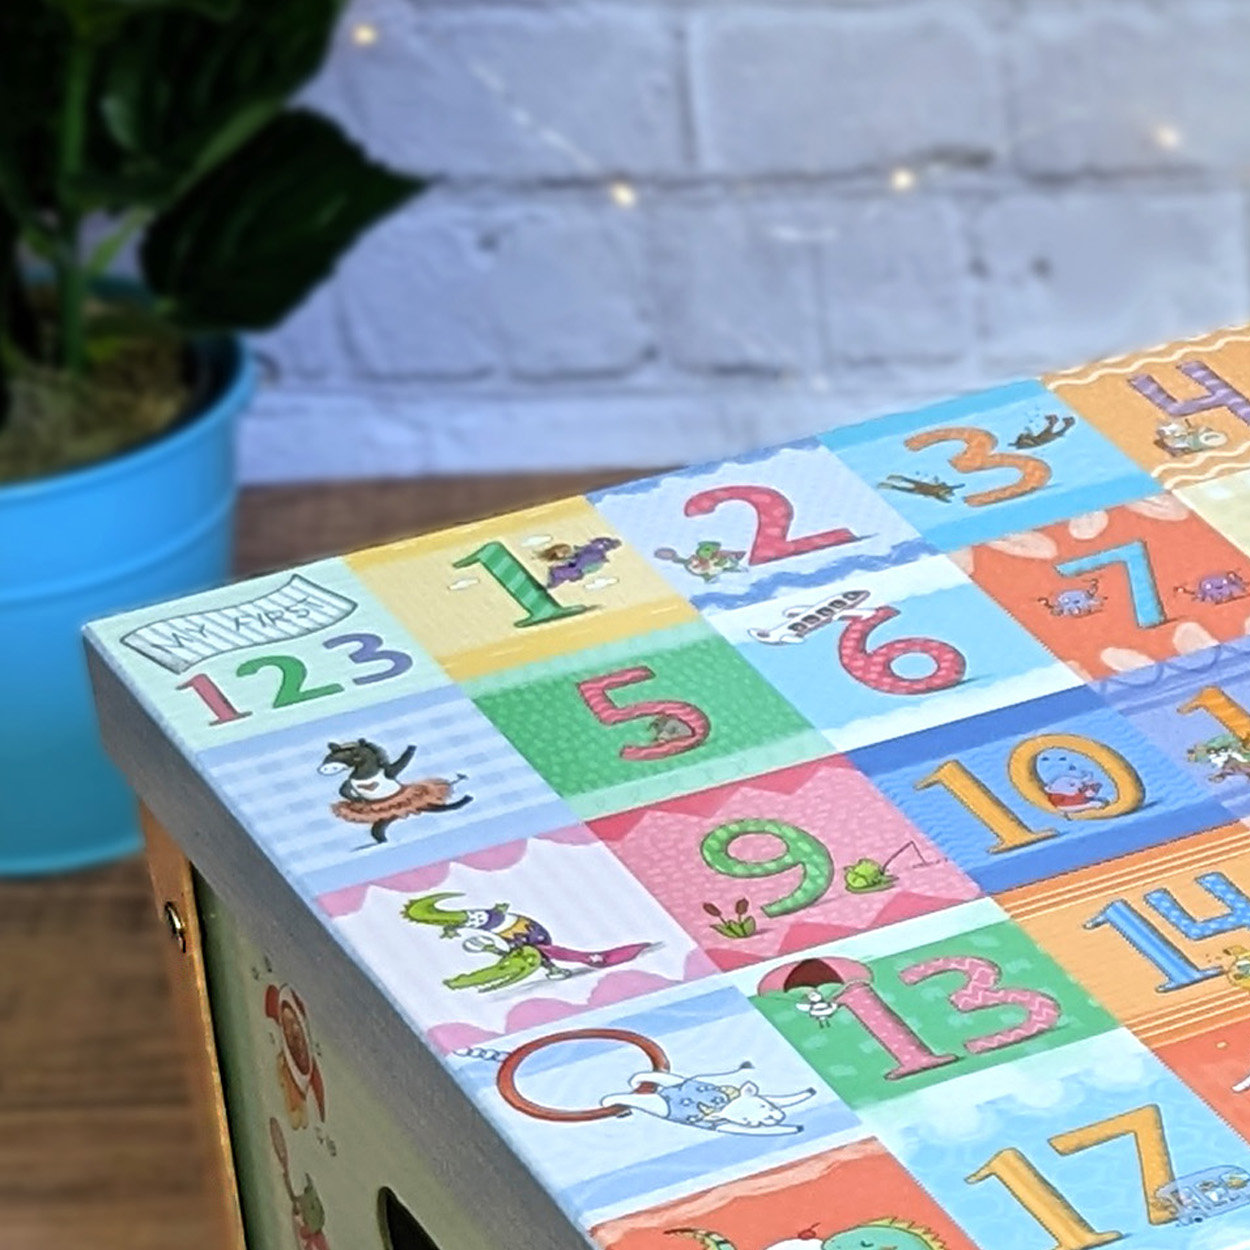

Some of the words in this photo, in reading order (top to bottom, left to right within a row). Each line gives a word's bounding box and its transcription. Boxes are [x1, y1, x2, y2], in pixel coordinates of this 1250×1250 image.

[904, 427, 1052, 506] 3
[684, 486, 854, 565] 2
[453, 541, 586, 627] 1
[1055, 539, 1165, 628] 7
[838, 606, 966, 693] 6
[579, 666, 710, 760] 5
[914, 733, 1145, 854] 10
[700, 819, 833, 917] 9
[838, 956, 1061, 1080] 13
